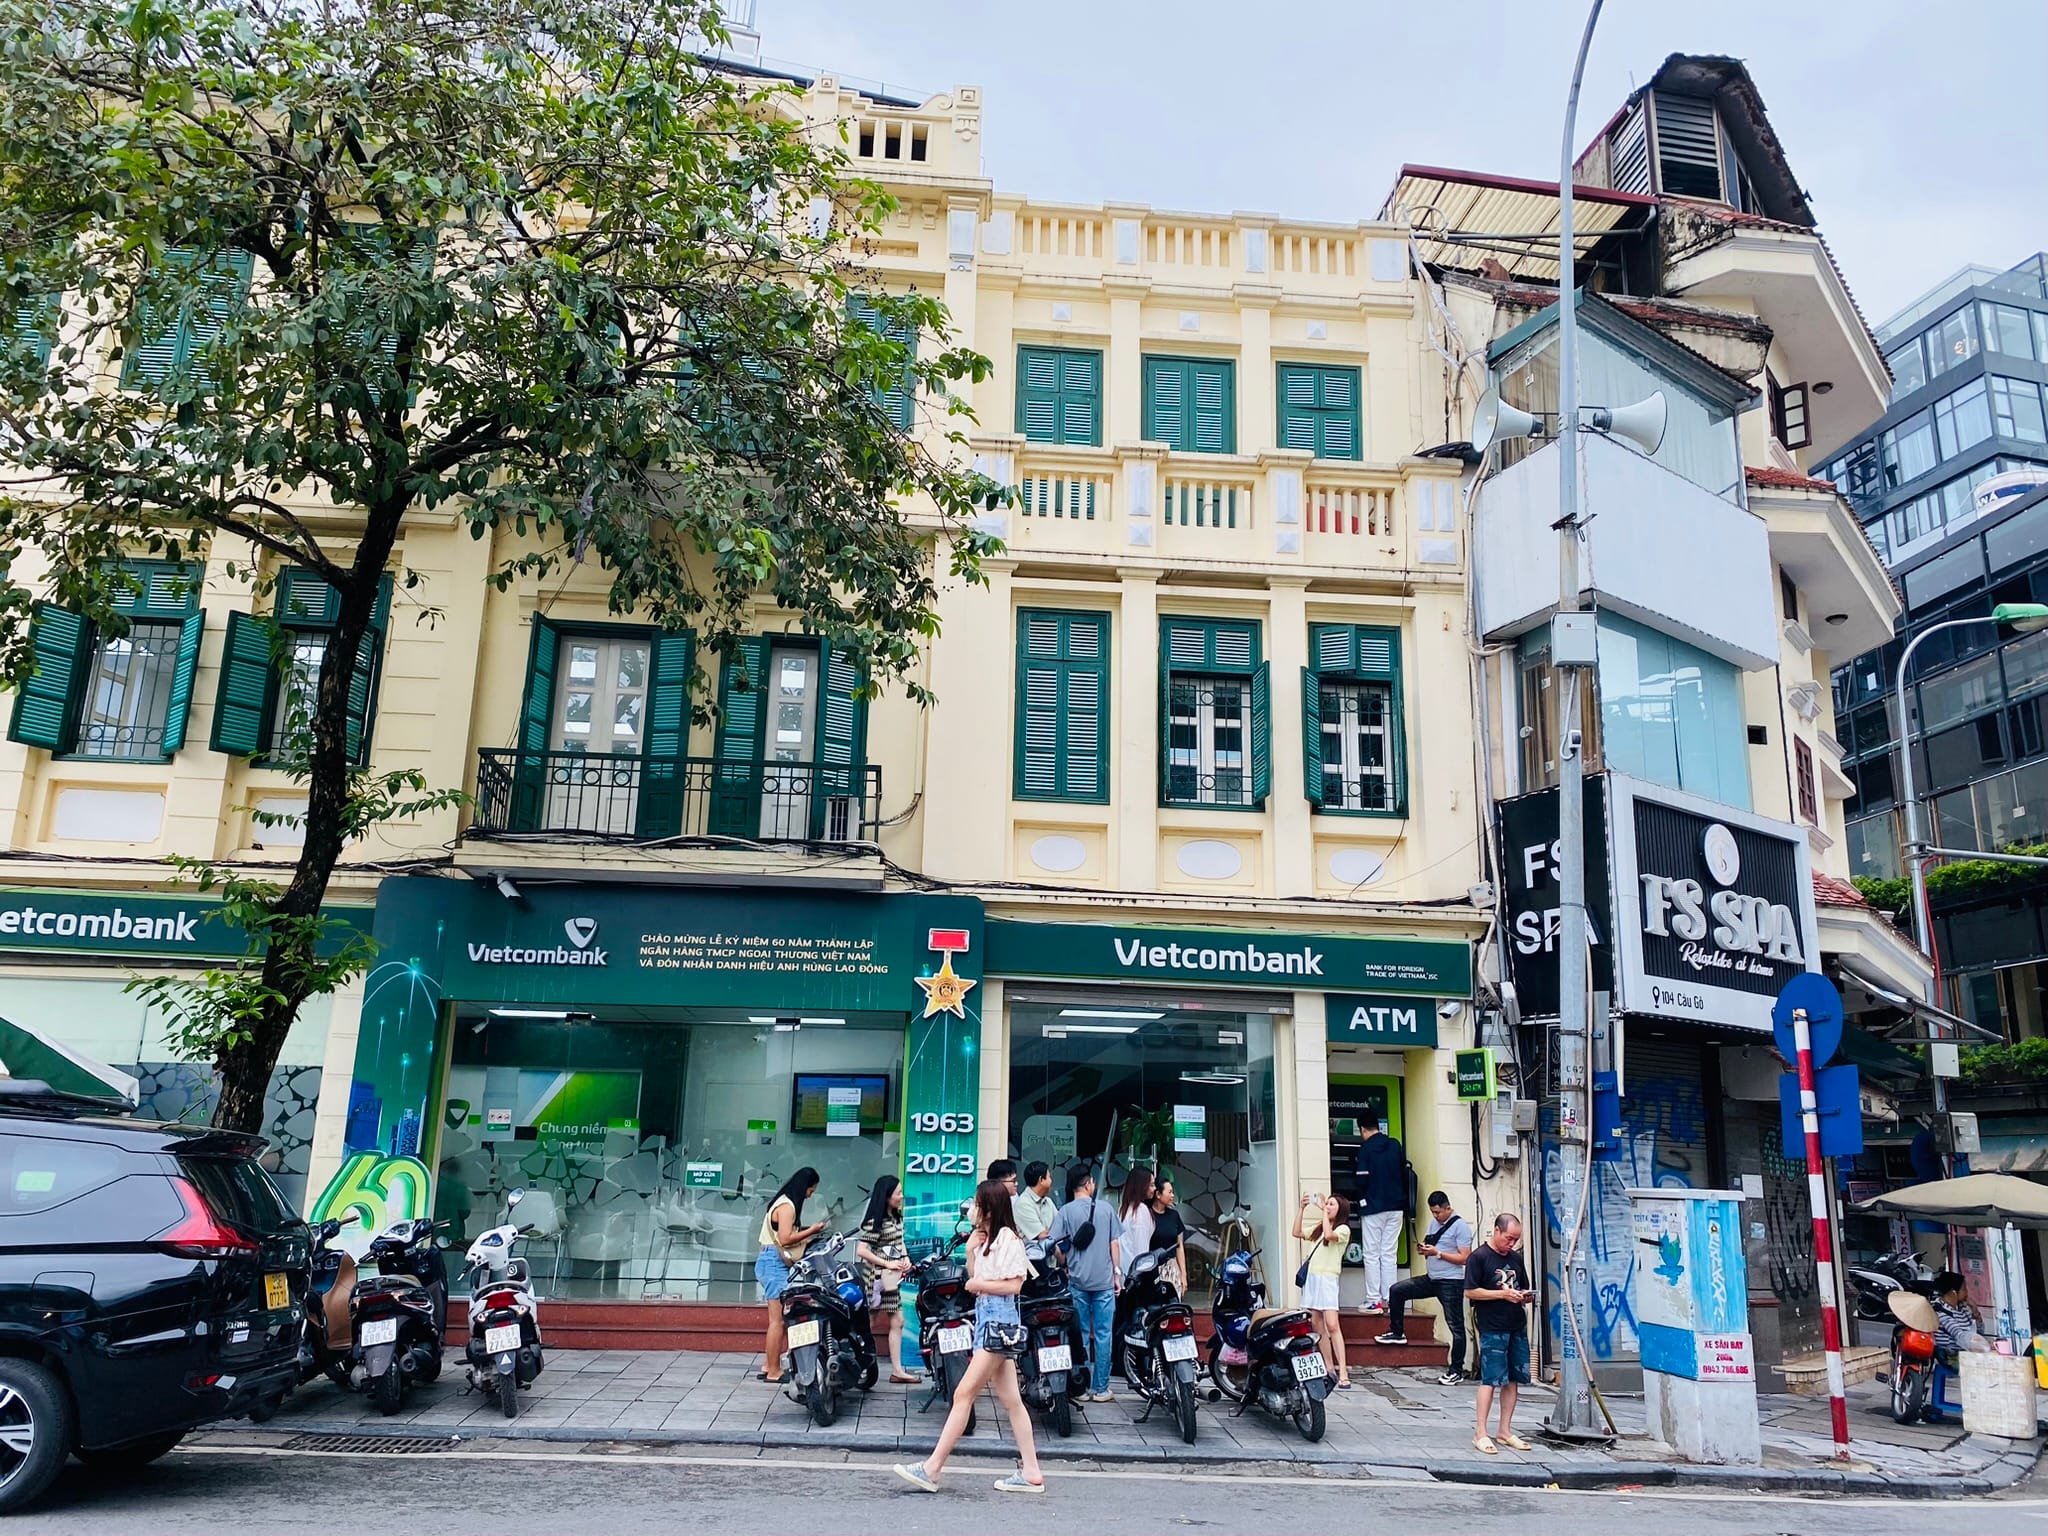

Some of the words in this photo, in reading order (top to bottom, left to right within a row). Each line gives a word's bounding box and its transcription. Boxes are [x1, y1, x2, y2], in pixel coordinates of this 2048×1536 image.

[1640, 873, 1707, 941] FS
[1711, 890, 1805, 964] SPA
[772, 938, 785, 946] 60
[467, 942, 608, 967] Vietcombank
[706, 948, 736, 956] TMCP
[821, 950, 844, 961] VIỆT
[847, 952, 871, 960] NAM
[1113, 938, 1324, 976] Vietcombank
[716, 961, 746, 969] DANH
[776, 962, 799, 971] ANH
[835, 964, 856, 972] LAO
[1661, 991, 1674, 1005] 104
[1349, 1006, 1417, 1033] ATM
[540, 1122, 578, 1136] Chung
[911, 1113, 974, 1132] 1963
[907, 1153, 975, 1174] 2023
[309, 1150, 432, 1240] 60
